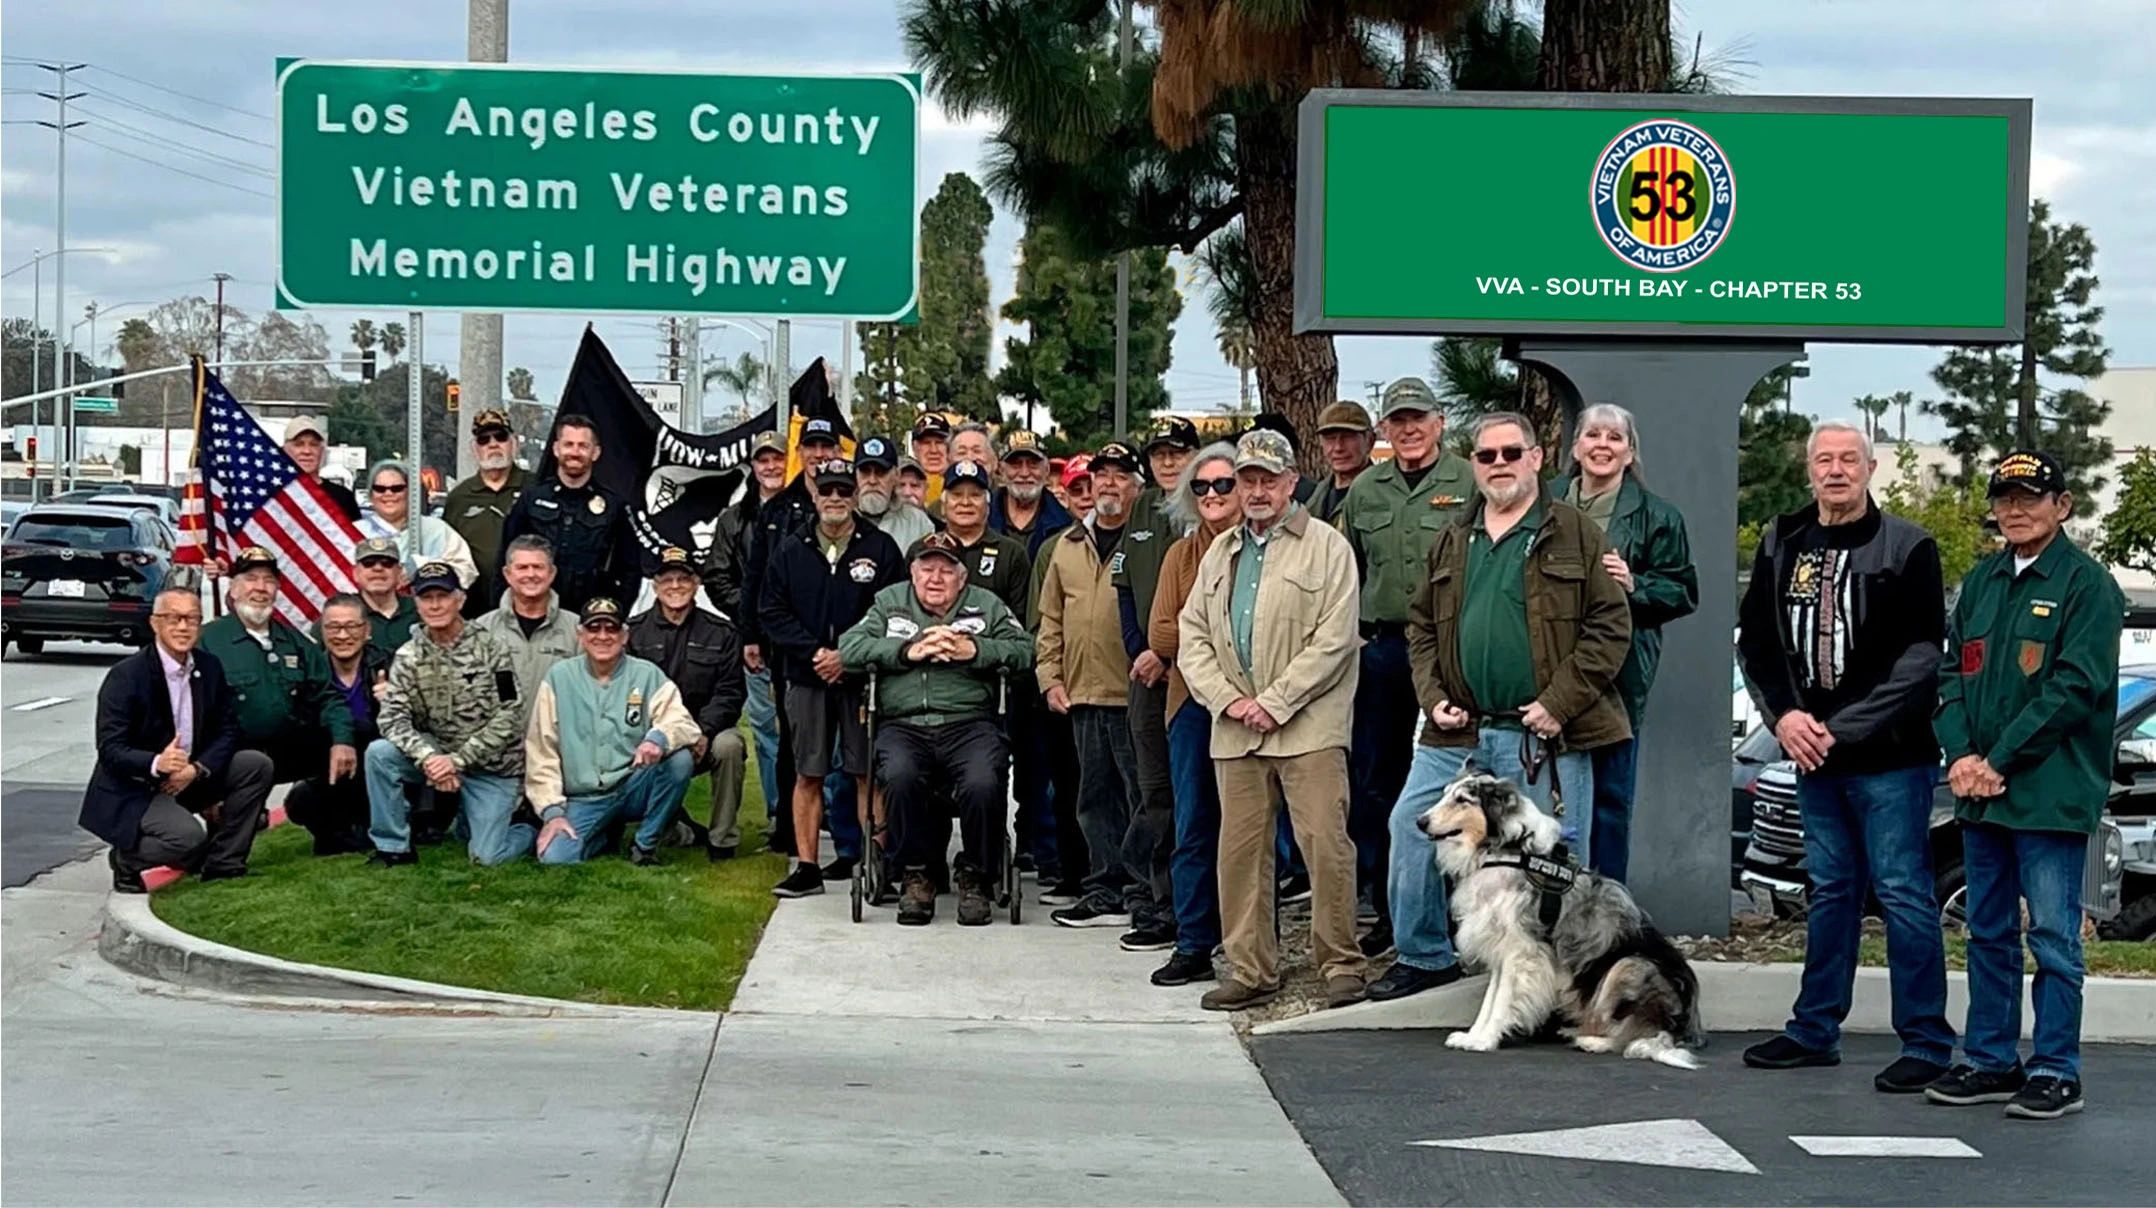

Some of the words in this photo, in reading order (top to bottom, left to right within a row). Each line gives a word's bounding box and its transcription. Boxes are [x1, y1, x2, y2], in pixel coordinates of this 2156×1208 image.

[317, 93, 408, 135] Los
[445, 97, 658, 151] Angeles
[689, 102, 880, 155] County
[352, 165, 578, 210] Vietnam
[610, 172, 849, 217] Veterans
[1597, 128, 1652, 205] VIETNAM
[1655, 126, 1730, 205] VETERANS
[1628, 170, 1697, 222] 53
[350, 238, 594, 282] Memorial
[627, 244, 847, 297] Highway
[1610, 226, 1634, 250] OF
[1631, 228, 1719, 266] AMERICA
[1475, 276, 1525, 295] VVA
[1546, 277, 1631, 297] SOUTH
[1639, 279, 1689, 297] BAY
[1709, 280, 1828, 300] CHAPTER
[1835, 282, 1862, 300] 53
[719, 433, 756, 469] MI
